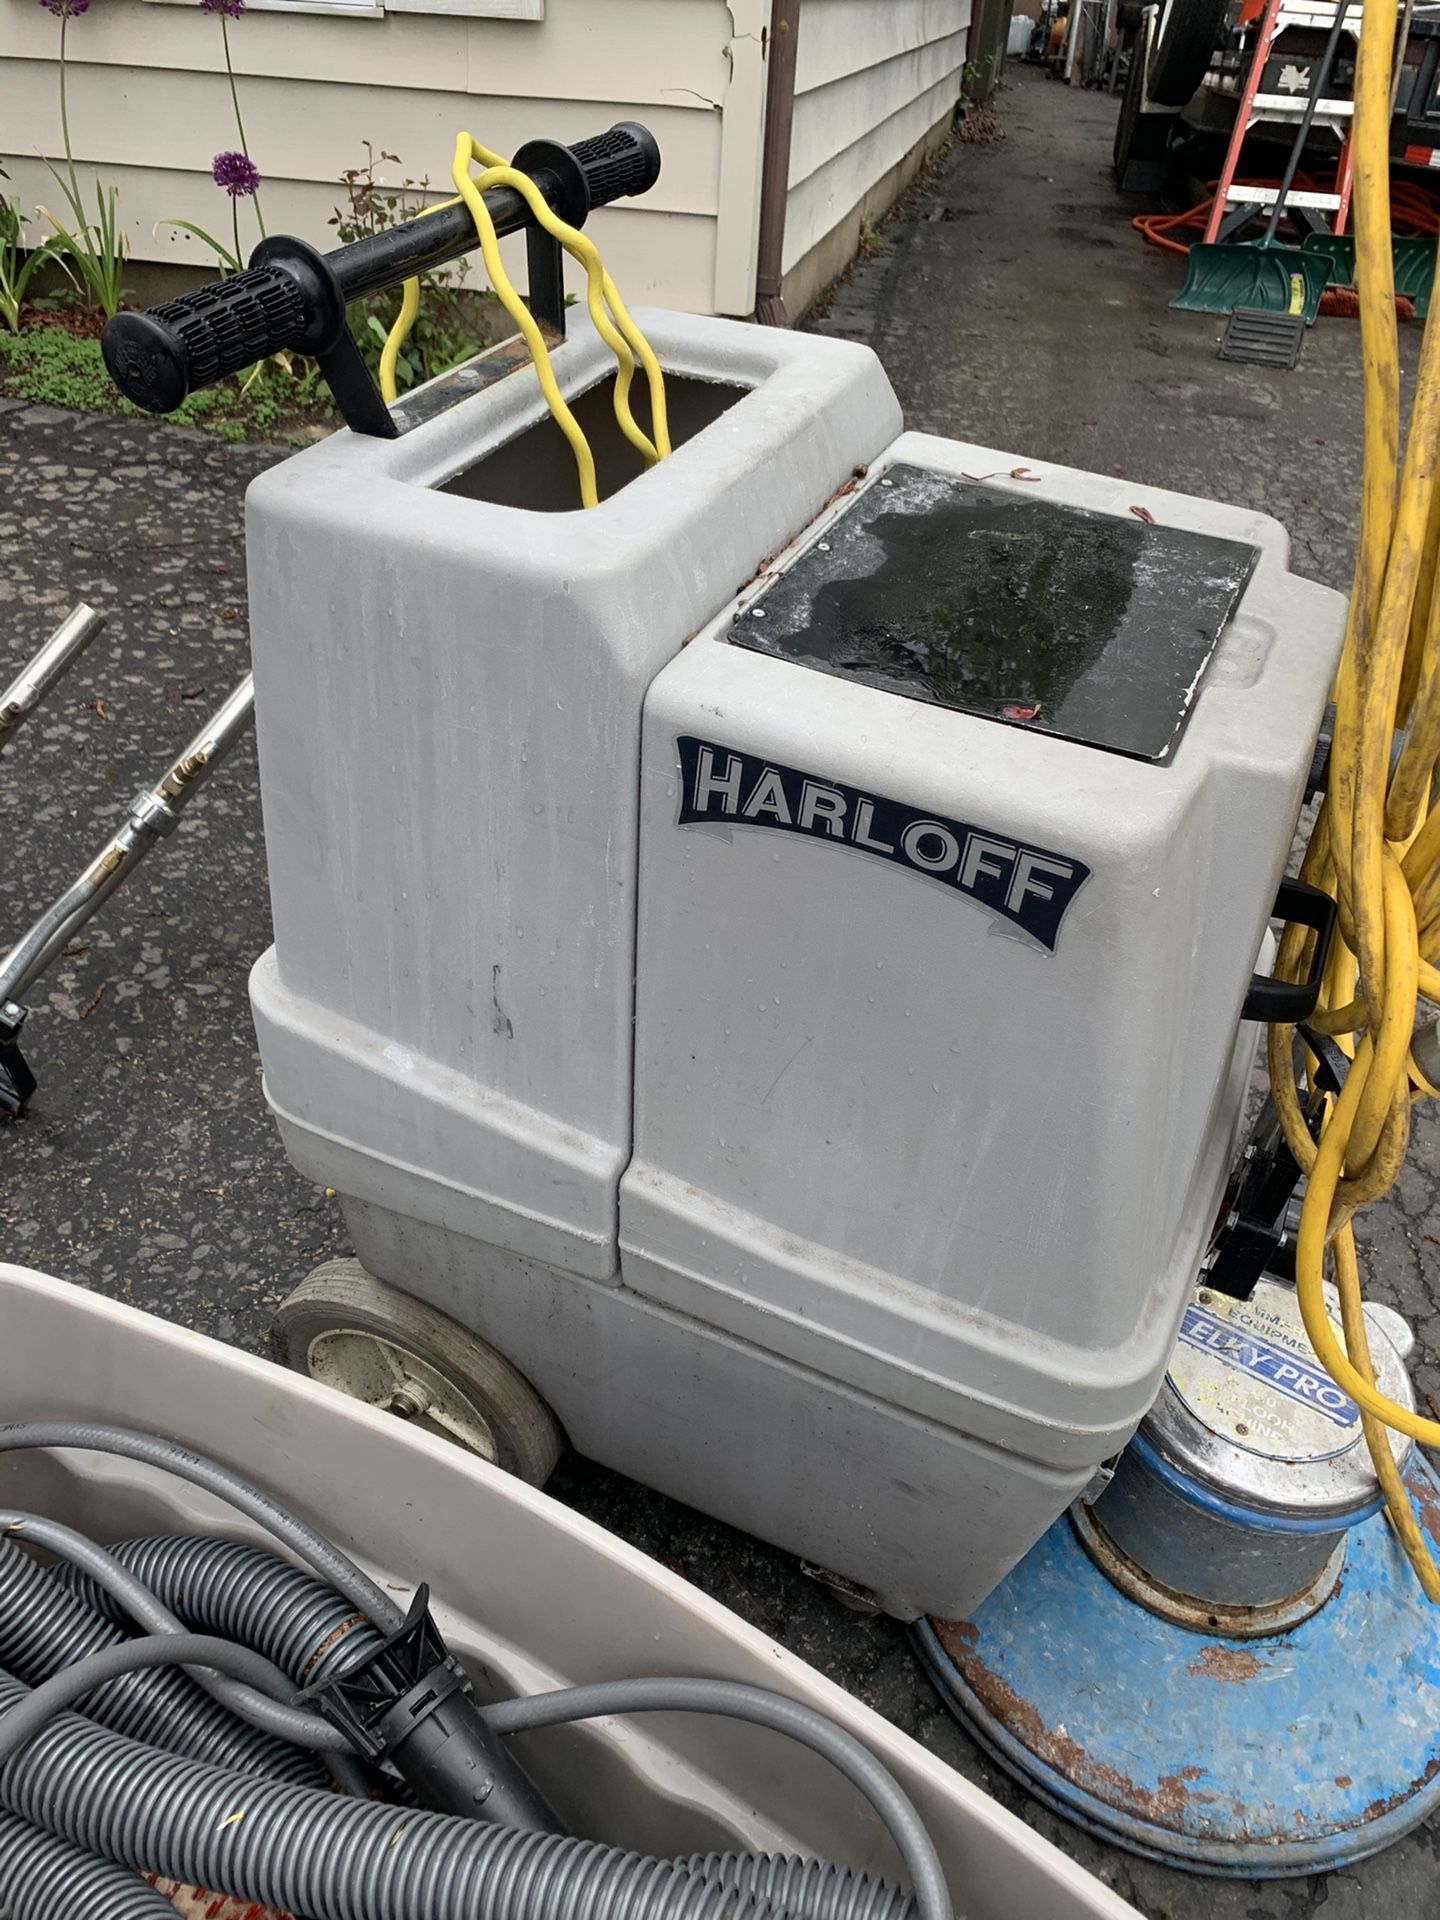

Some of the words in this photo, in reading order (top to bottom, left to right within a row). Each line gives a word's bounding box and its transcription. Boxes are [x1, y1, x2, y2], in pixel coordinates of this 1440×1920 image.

[694, 745, 1074, 913] HARLOFF
[1228, 1308, 1312, 1354] EQUIPME
[1274, 1364, 1348, 1409] PRO
